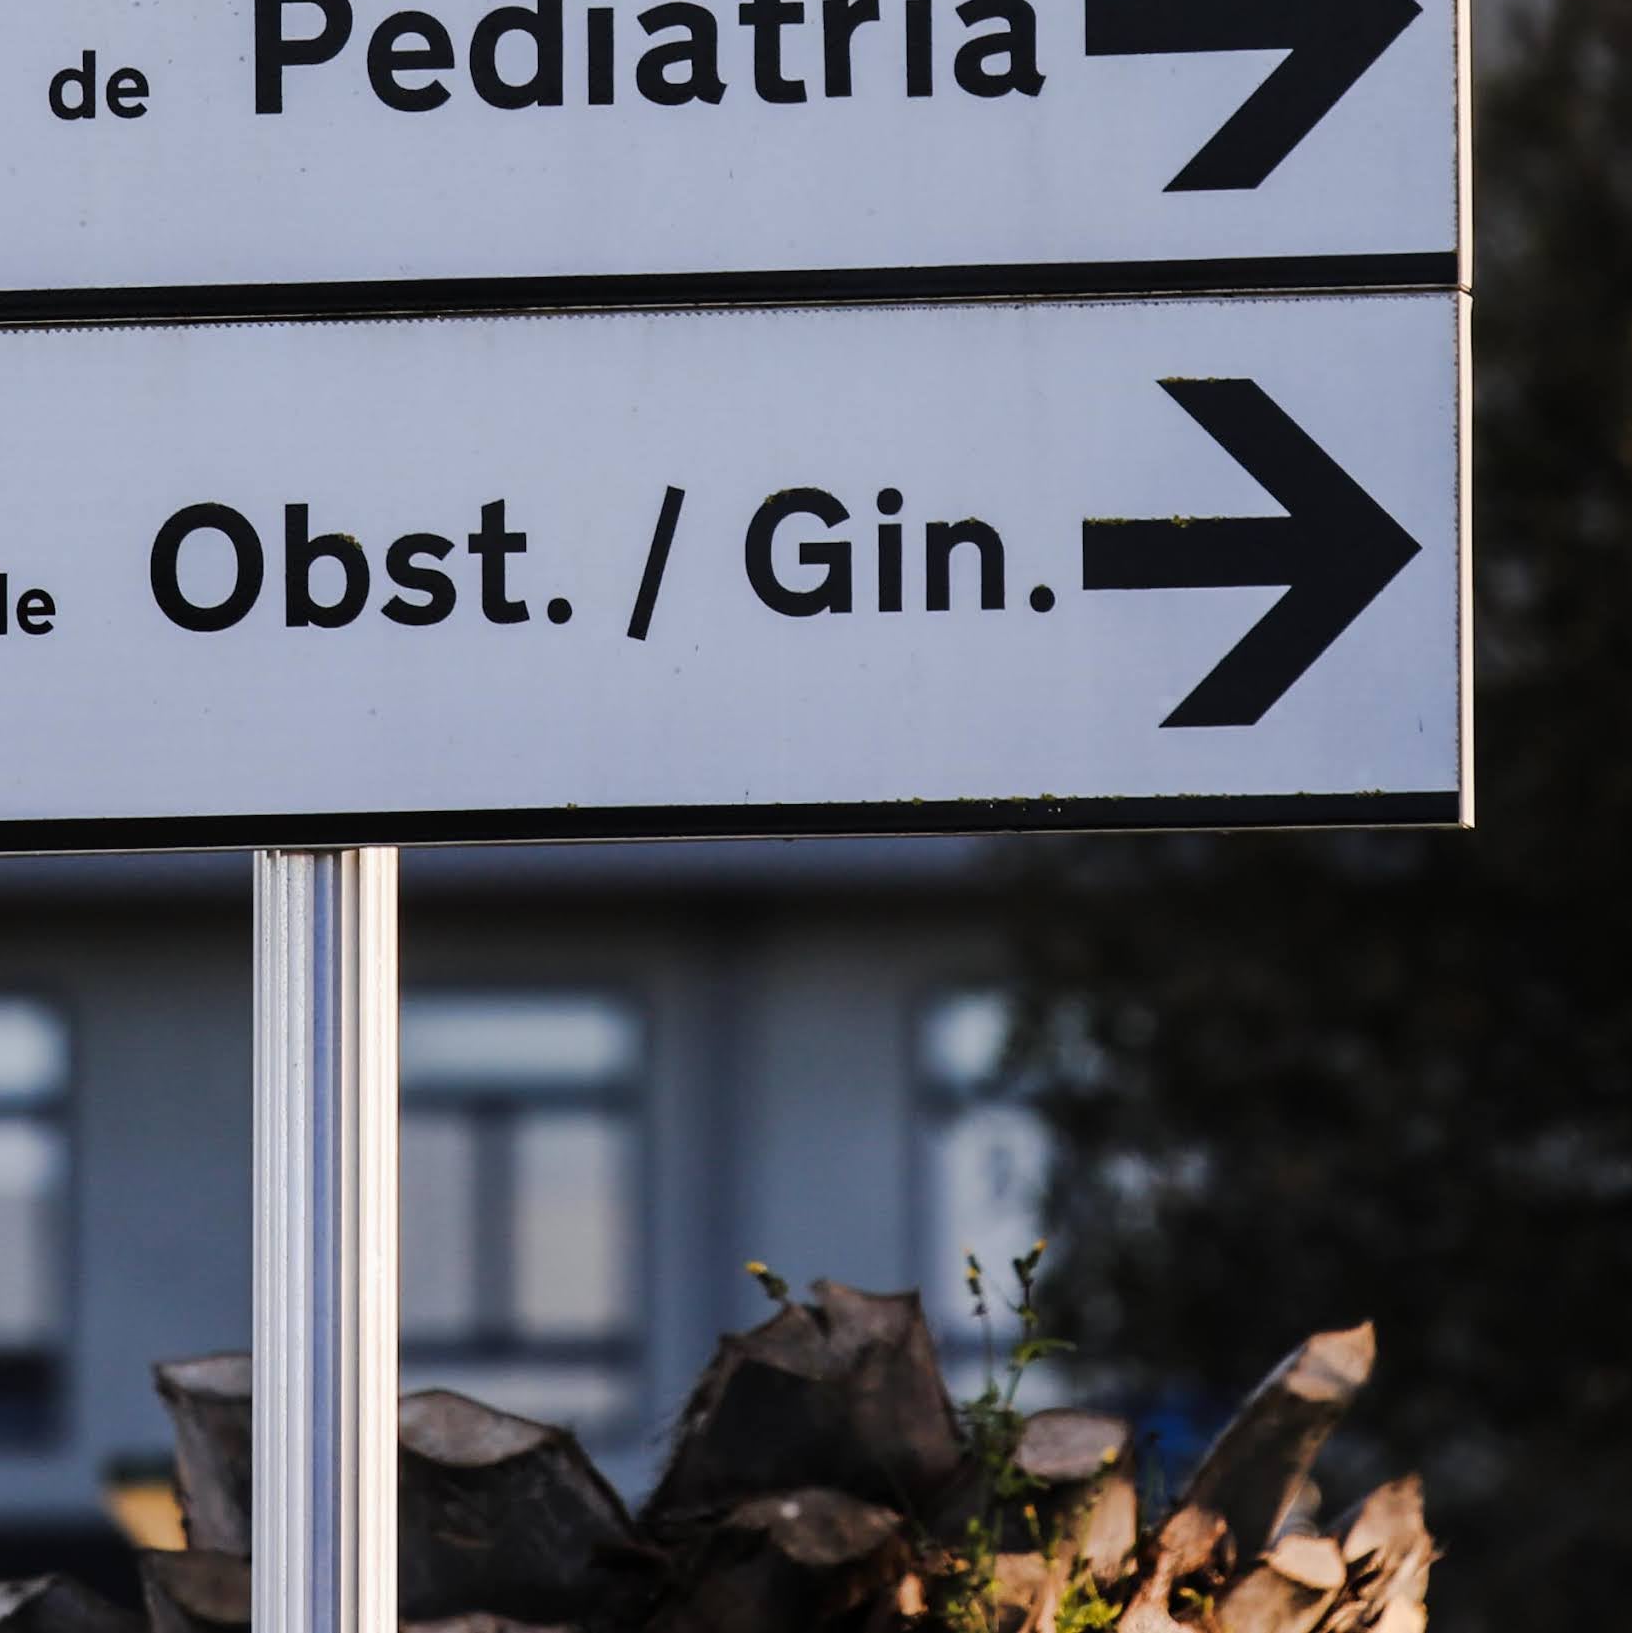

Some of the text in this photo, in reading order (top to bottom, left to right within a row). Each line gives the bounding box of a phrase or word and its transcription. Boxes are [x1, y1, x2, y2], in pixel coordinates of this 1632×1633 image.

[48, 49, 150, 121] de
[150, 498, 573, 633] Obst.
[626, 485, 686, 642] /
[744, 486, 1056, 618] Gin.
